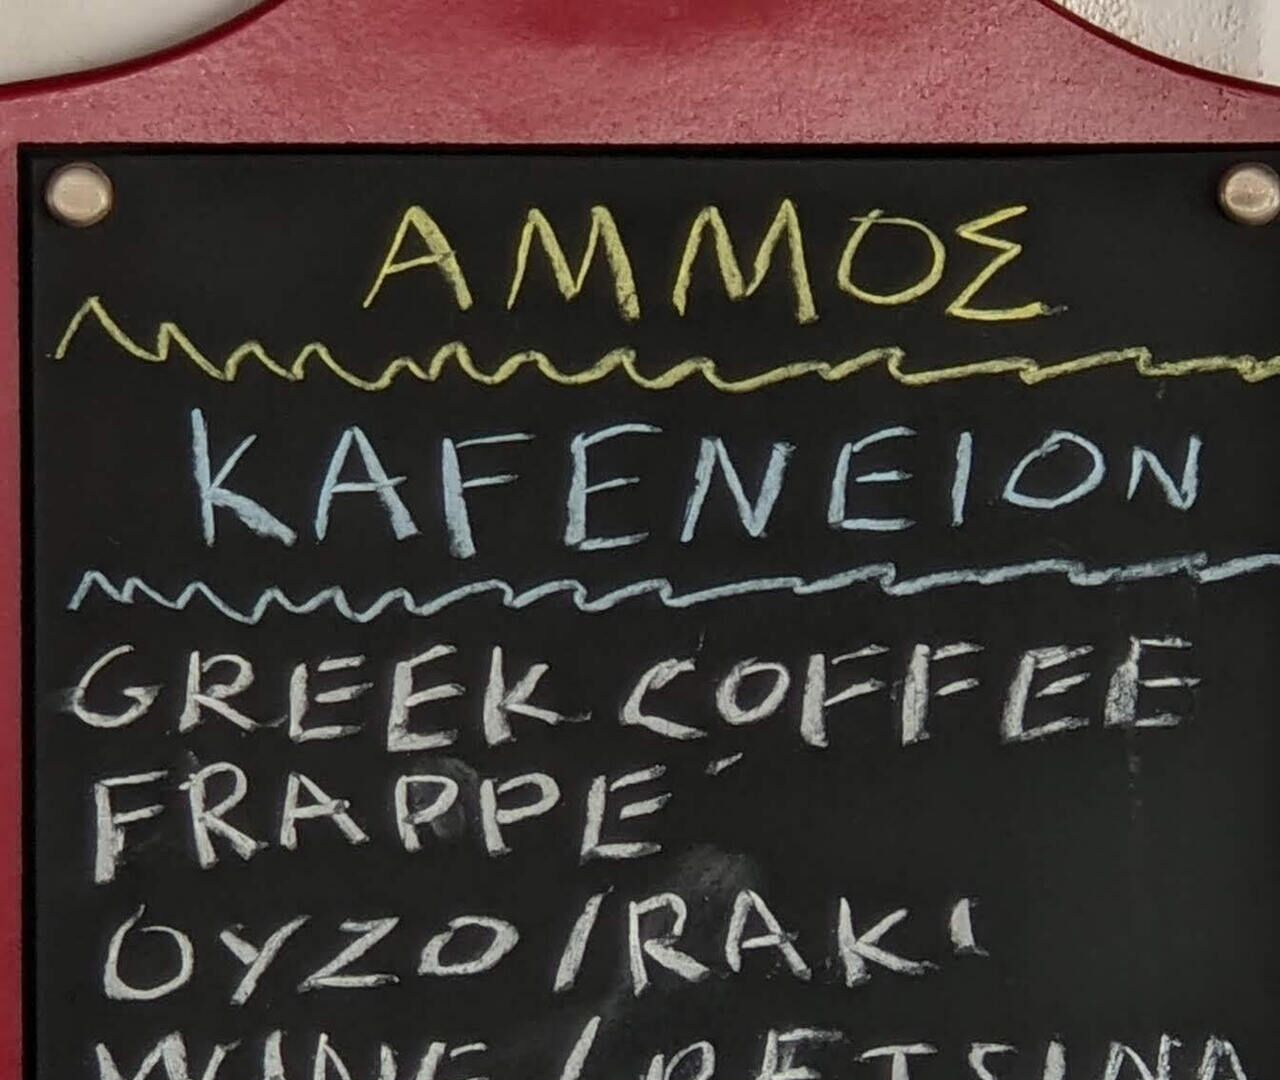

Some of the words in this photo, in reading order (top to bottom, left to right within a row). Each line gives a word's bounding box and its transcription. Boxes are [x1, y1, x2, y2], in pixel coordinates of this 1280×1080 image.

[190, 409, 1204, 558] KAFENEION
[70, 645, 585, 752] GREEK
[620, 636, 1202, 748] COFFEE
